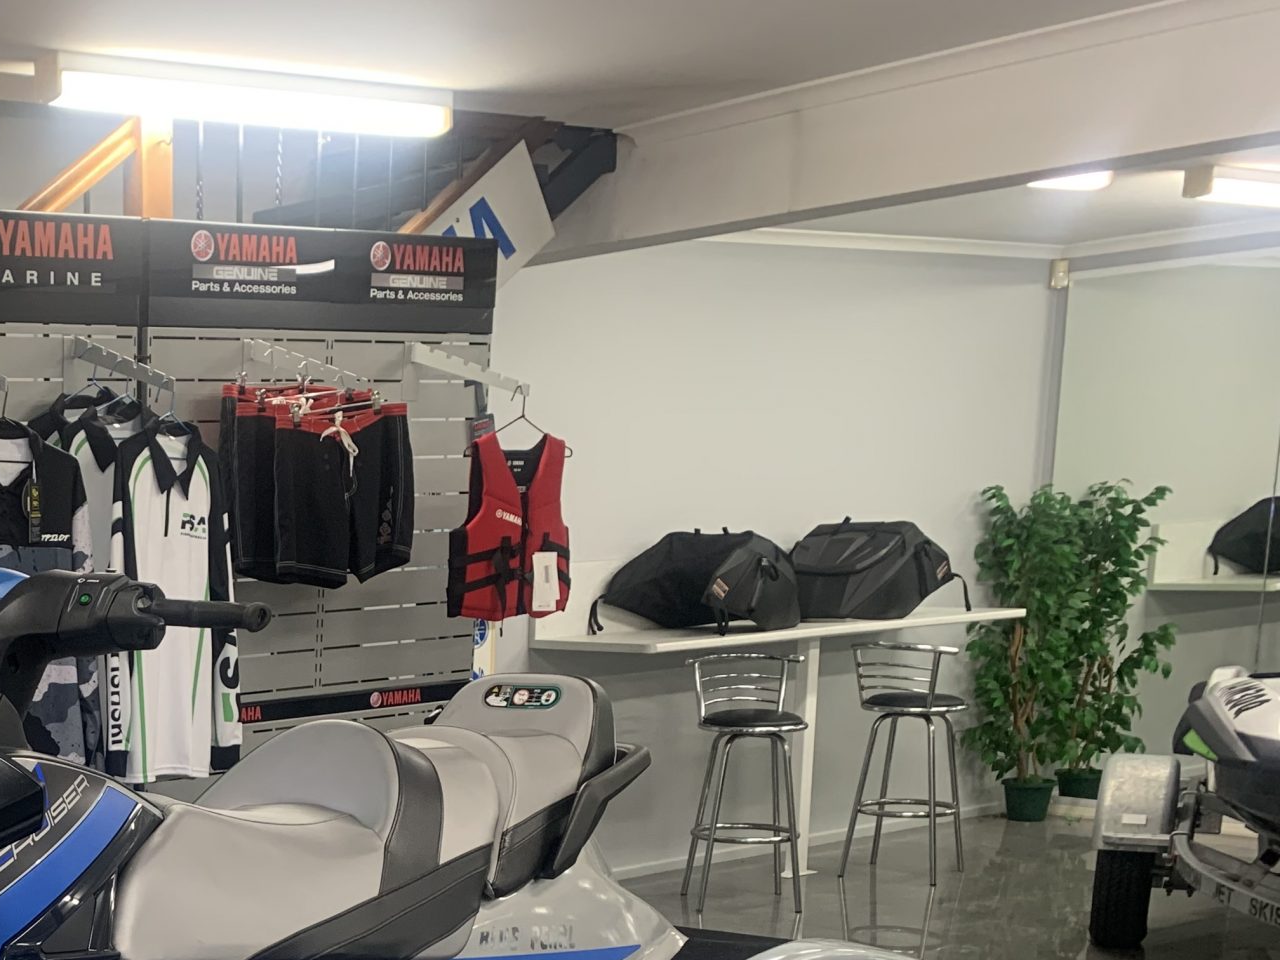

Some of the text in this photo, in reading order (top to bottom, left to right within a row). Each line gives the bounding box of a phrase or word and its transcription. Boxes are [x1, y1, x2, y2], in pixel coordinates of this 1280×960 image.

[216, 233, 298, 264] YAMAHA
[393, 243, 464, 273] YAMAHA
[213, 266, 278, 281] GENUINE
[191, 281, 297, 295] Parts & Accessories
[389, 275, 447, 289] GENUINE
[370, 289, 463, 301] Parts & Accessories
[382, 689, 421, 706] YAMAHA
